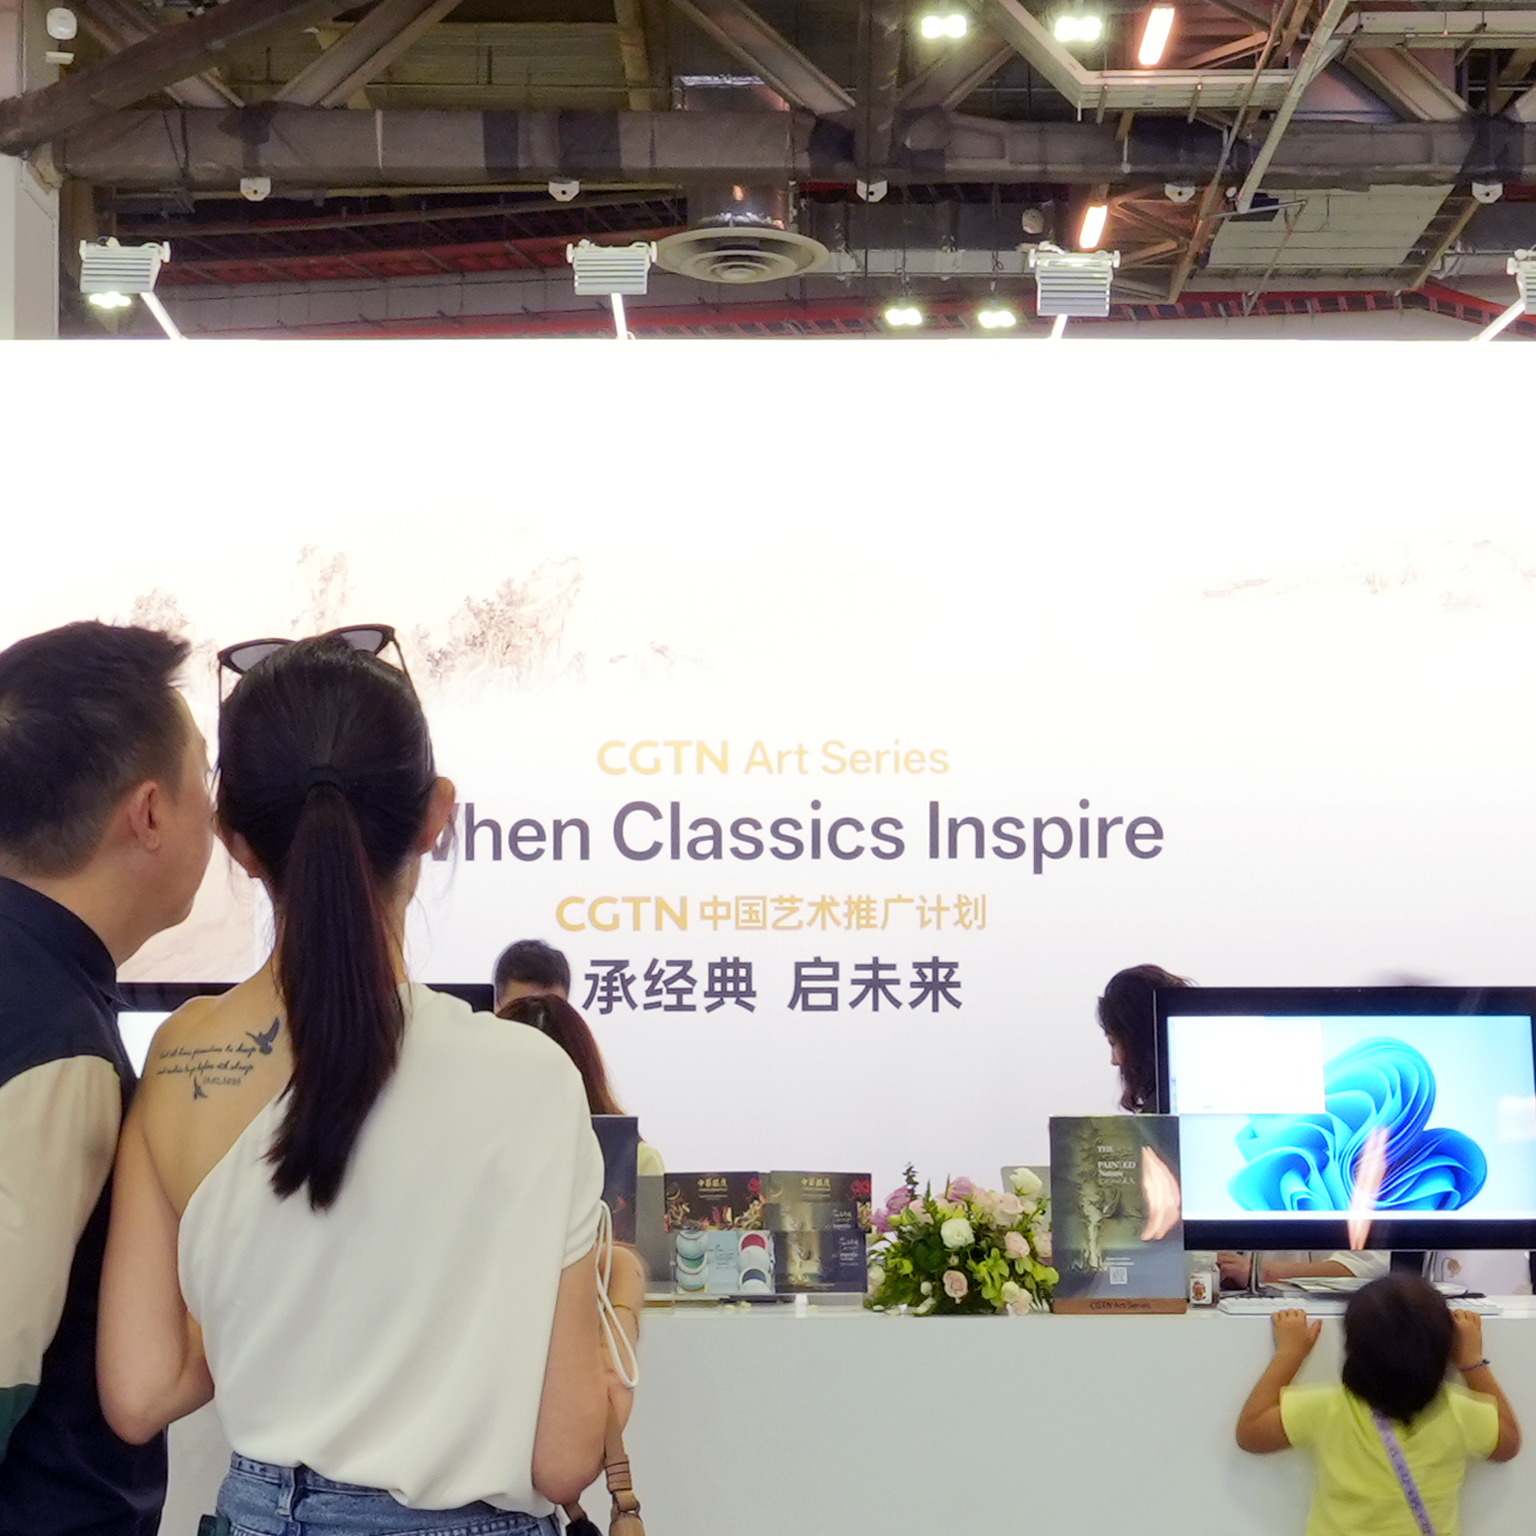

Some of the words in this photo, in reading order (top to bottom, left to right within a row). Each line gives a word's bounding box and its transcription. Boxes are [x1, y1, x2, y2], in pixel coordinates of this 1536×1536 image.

[596, 739, 730, 776] CGTN
[744, 739, 808, 776] Art
[821, 738, 950, 776] Series
[613, 799, 906, 862] Classics
[929, 799, 1164, 875] Inspire
[556, 896, 689, 932] CGTN
[700, 893, 988, 932] 中国艺术推广计划
[582, 956, 757, 1015] 承经典
[786, 956, 963, 1015] 启未来
